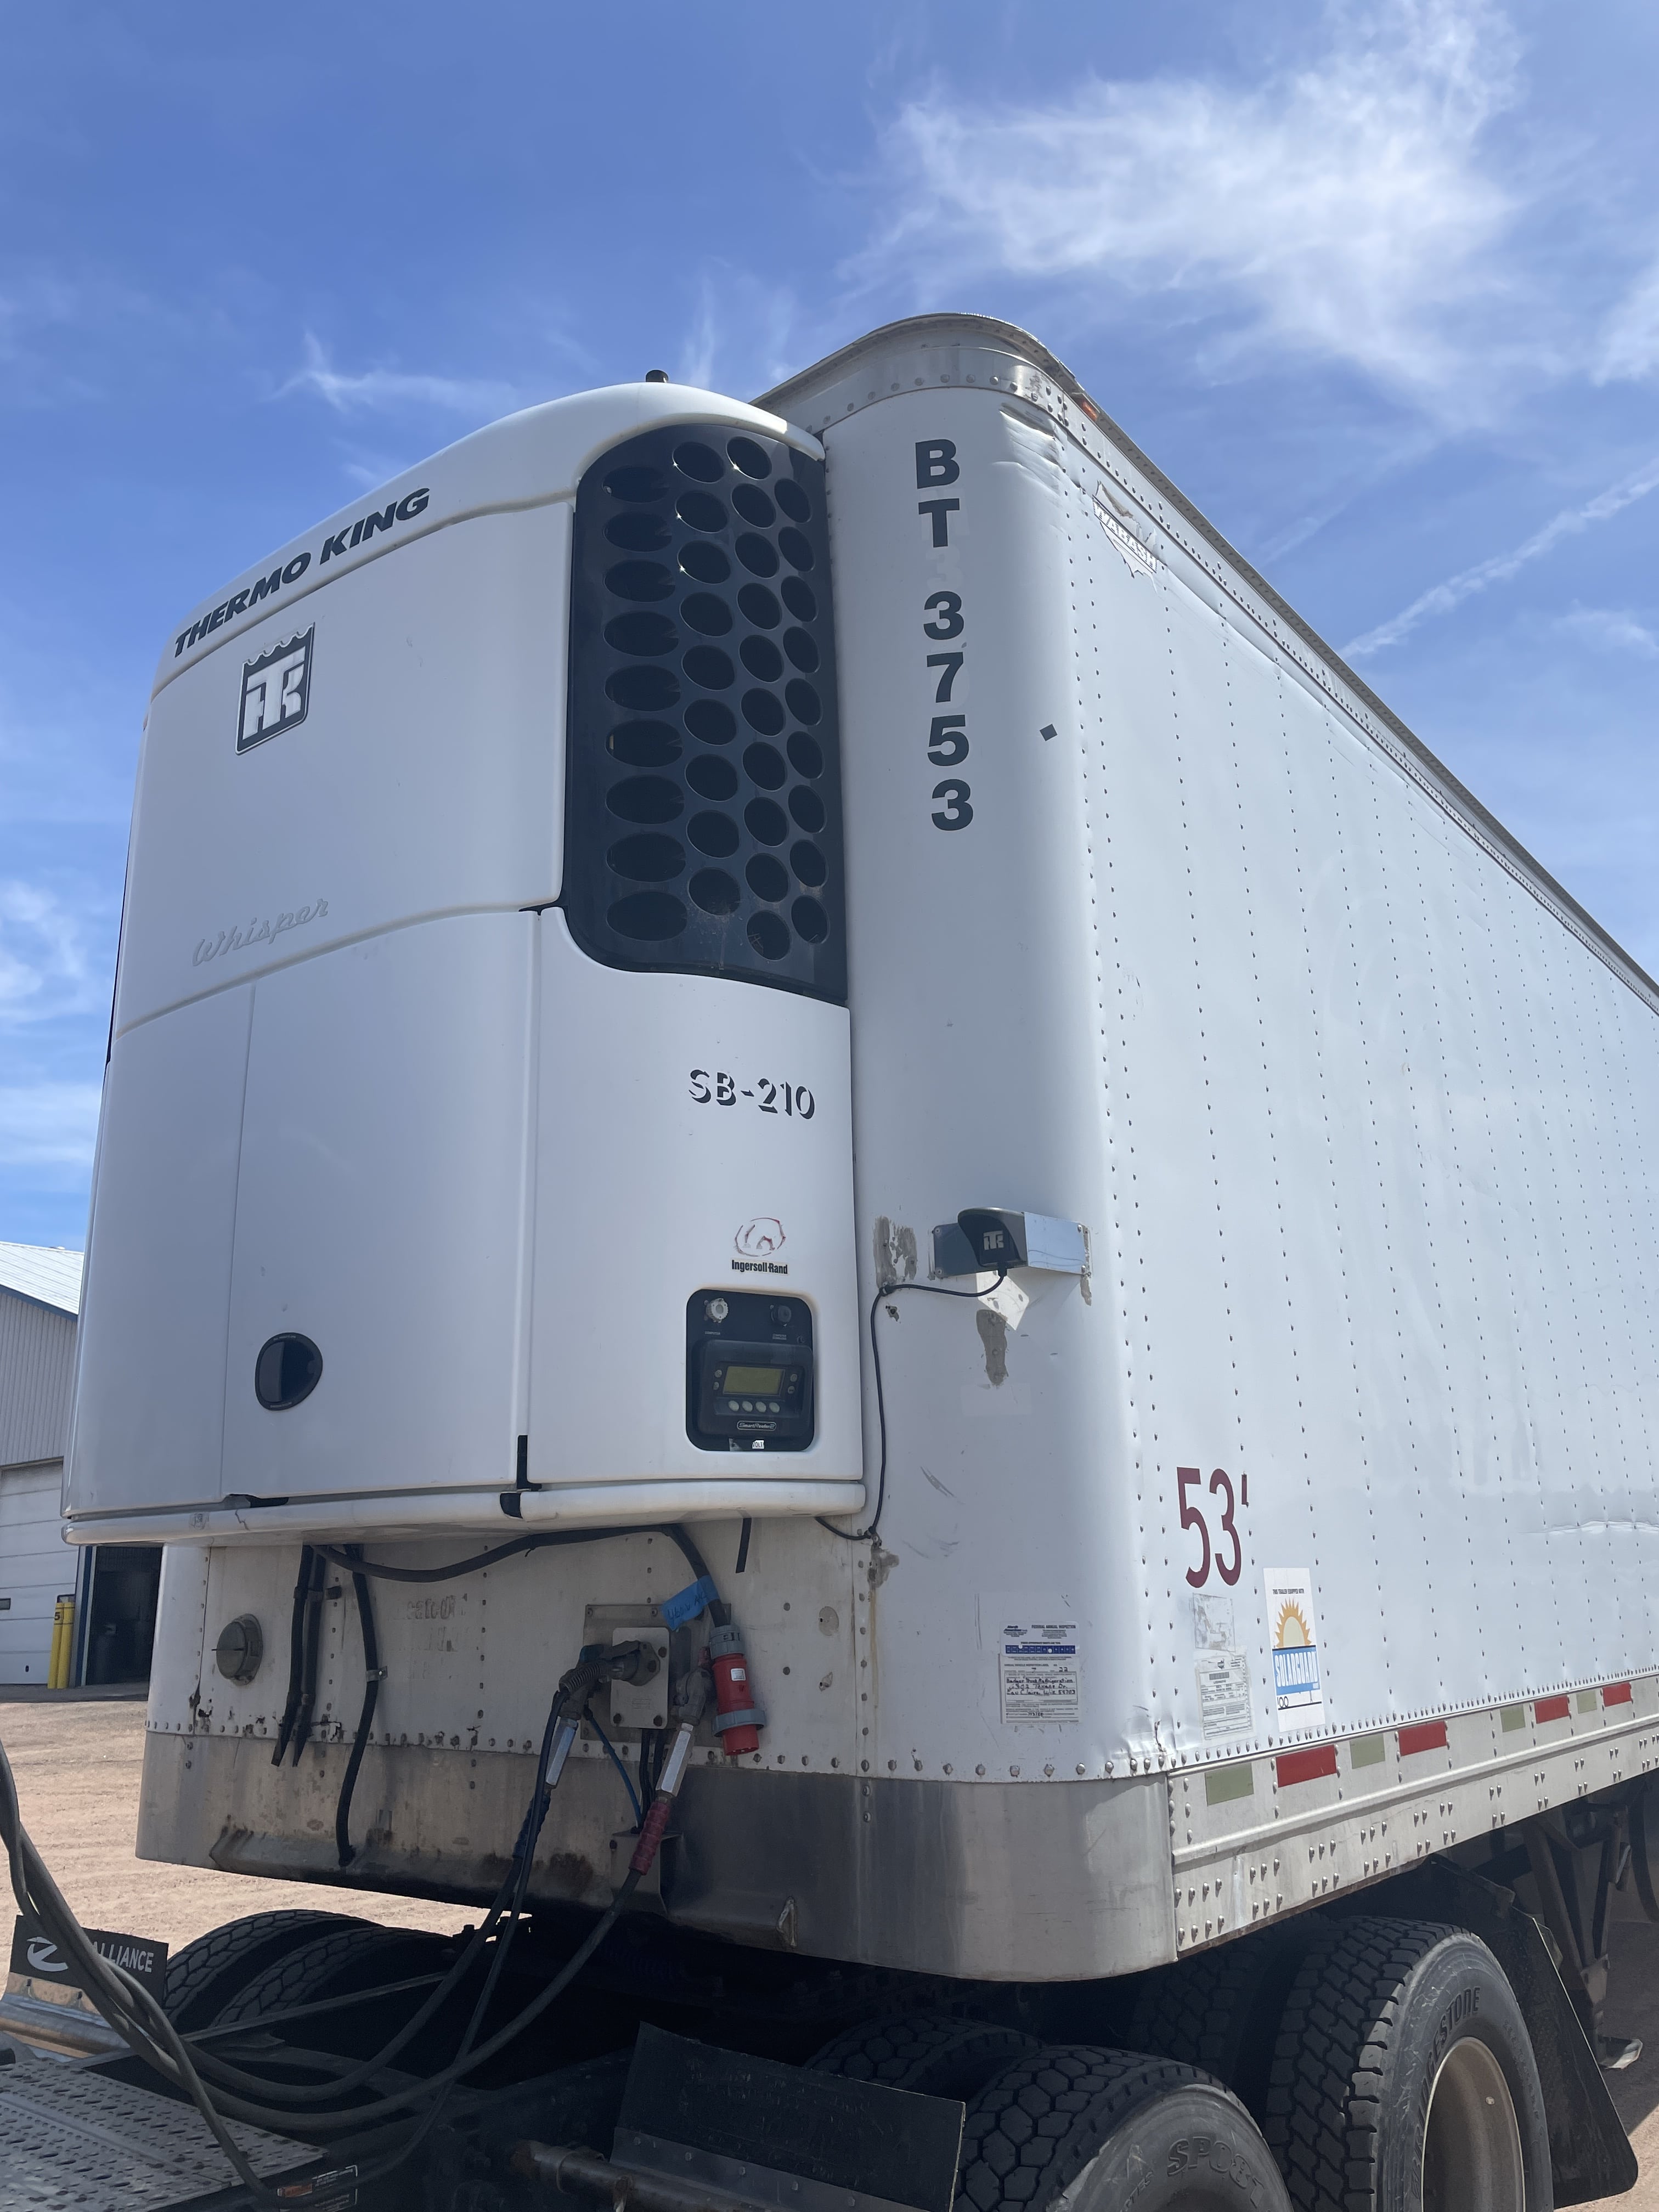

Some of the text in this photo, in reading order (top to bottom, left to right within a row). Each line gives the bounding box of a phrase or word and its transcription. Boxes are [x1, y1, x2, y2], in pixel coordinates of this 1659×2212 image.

[174, 487, 430, 658] THERMO KING
[923, 591, 974, 832] 3753
[192, 898, 329, 967] Whisper
[688, 1069, 815, 1120] SB-210
[1274, 1651, 1318, 1688] SOLARGUARD
